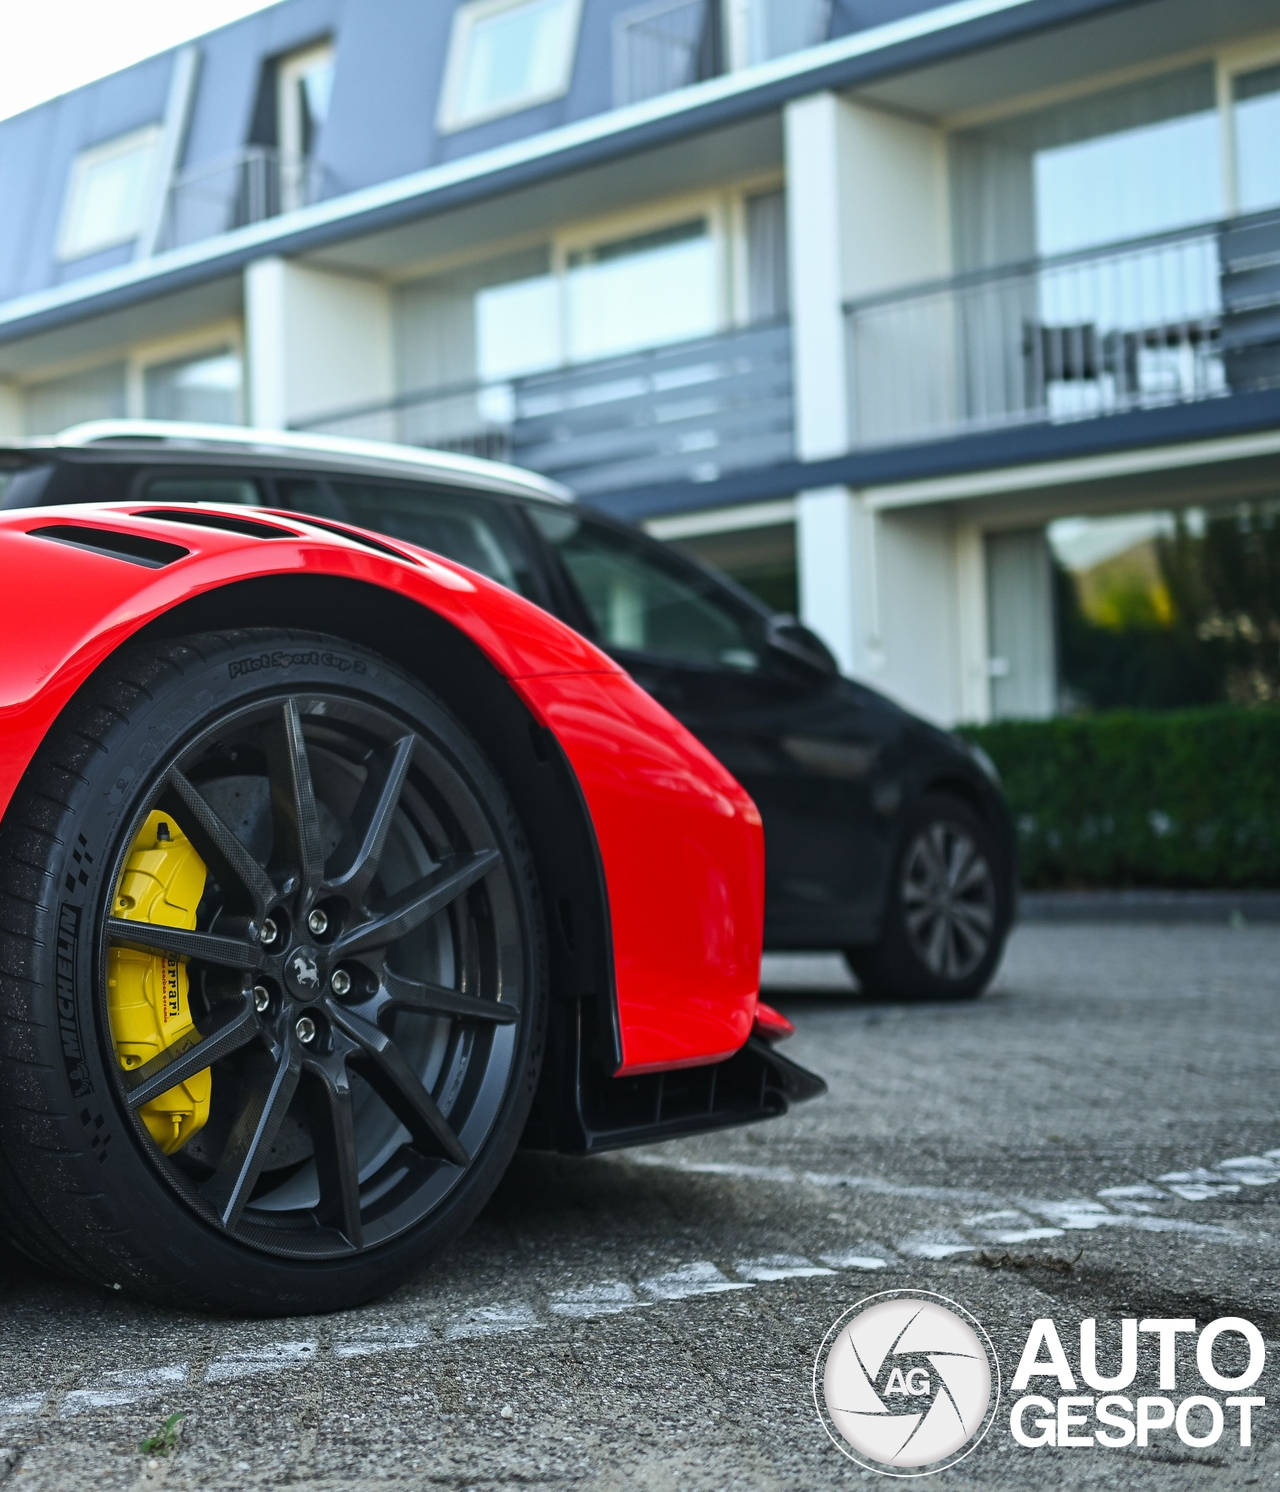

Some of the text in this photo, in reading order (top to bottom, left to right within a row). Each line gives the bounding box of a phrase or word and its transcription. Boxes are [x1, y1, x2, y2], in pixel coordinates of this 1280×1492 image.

[228, 652, 367, 679] Pilot Sport Cup 2
[57, 904, 81, 1058] MICHELIN
[168, 952, 180, 1017] errari
